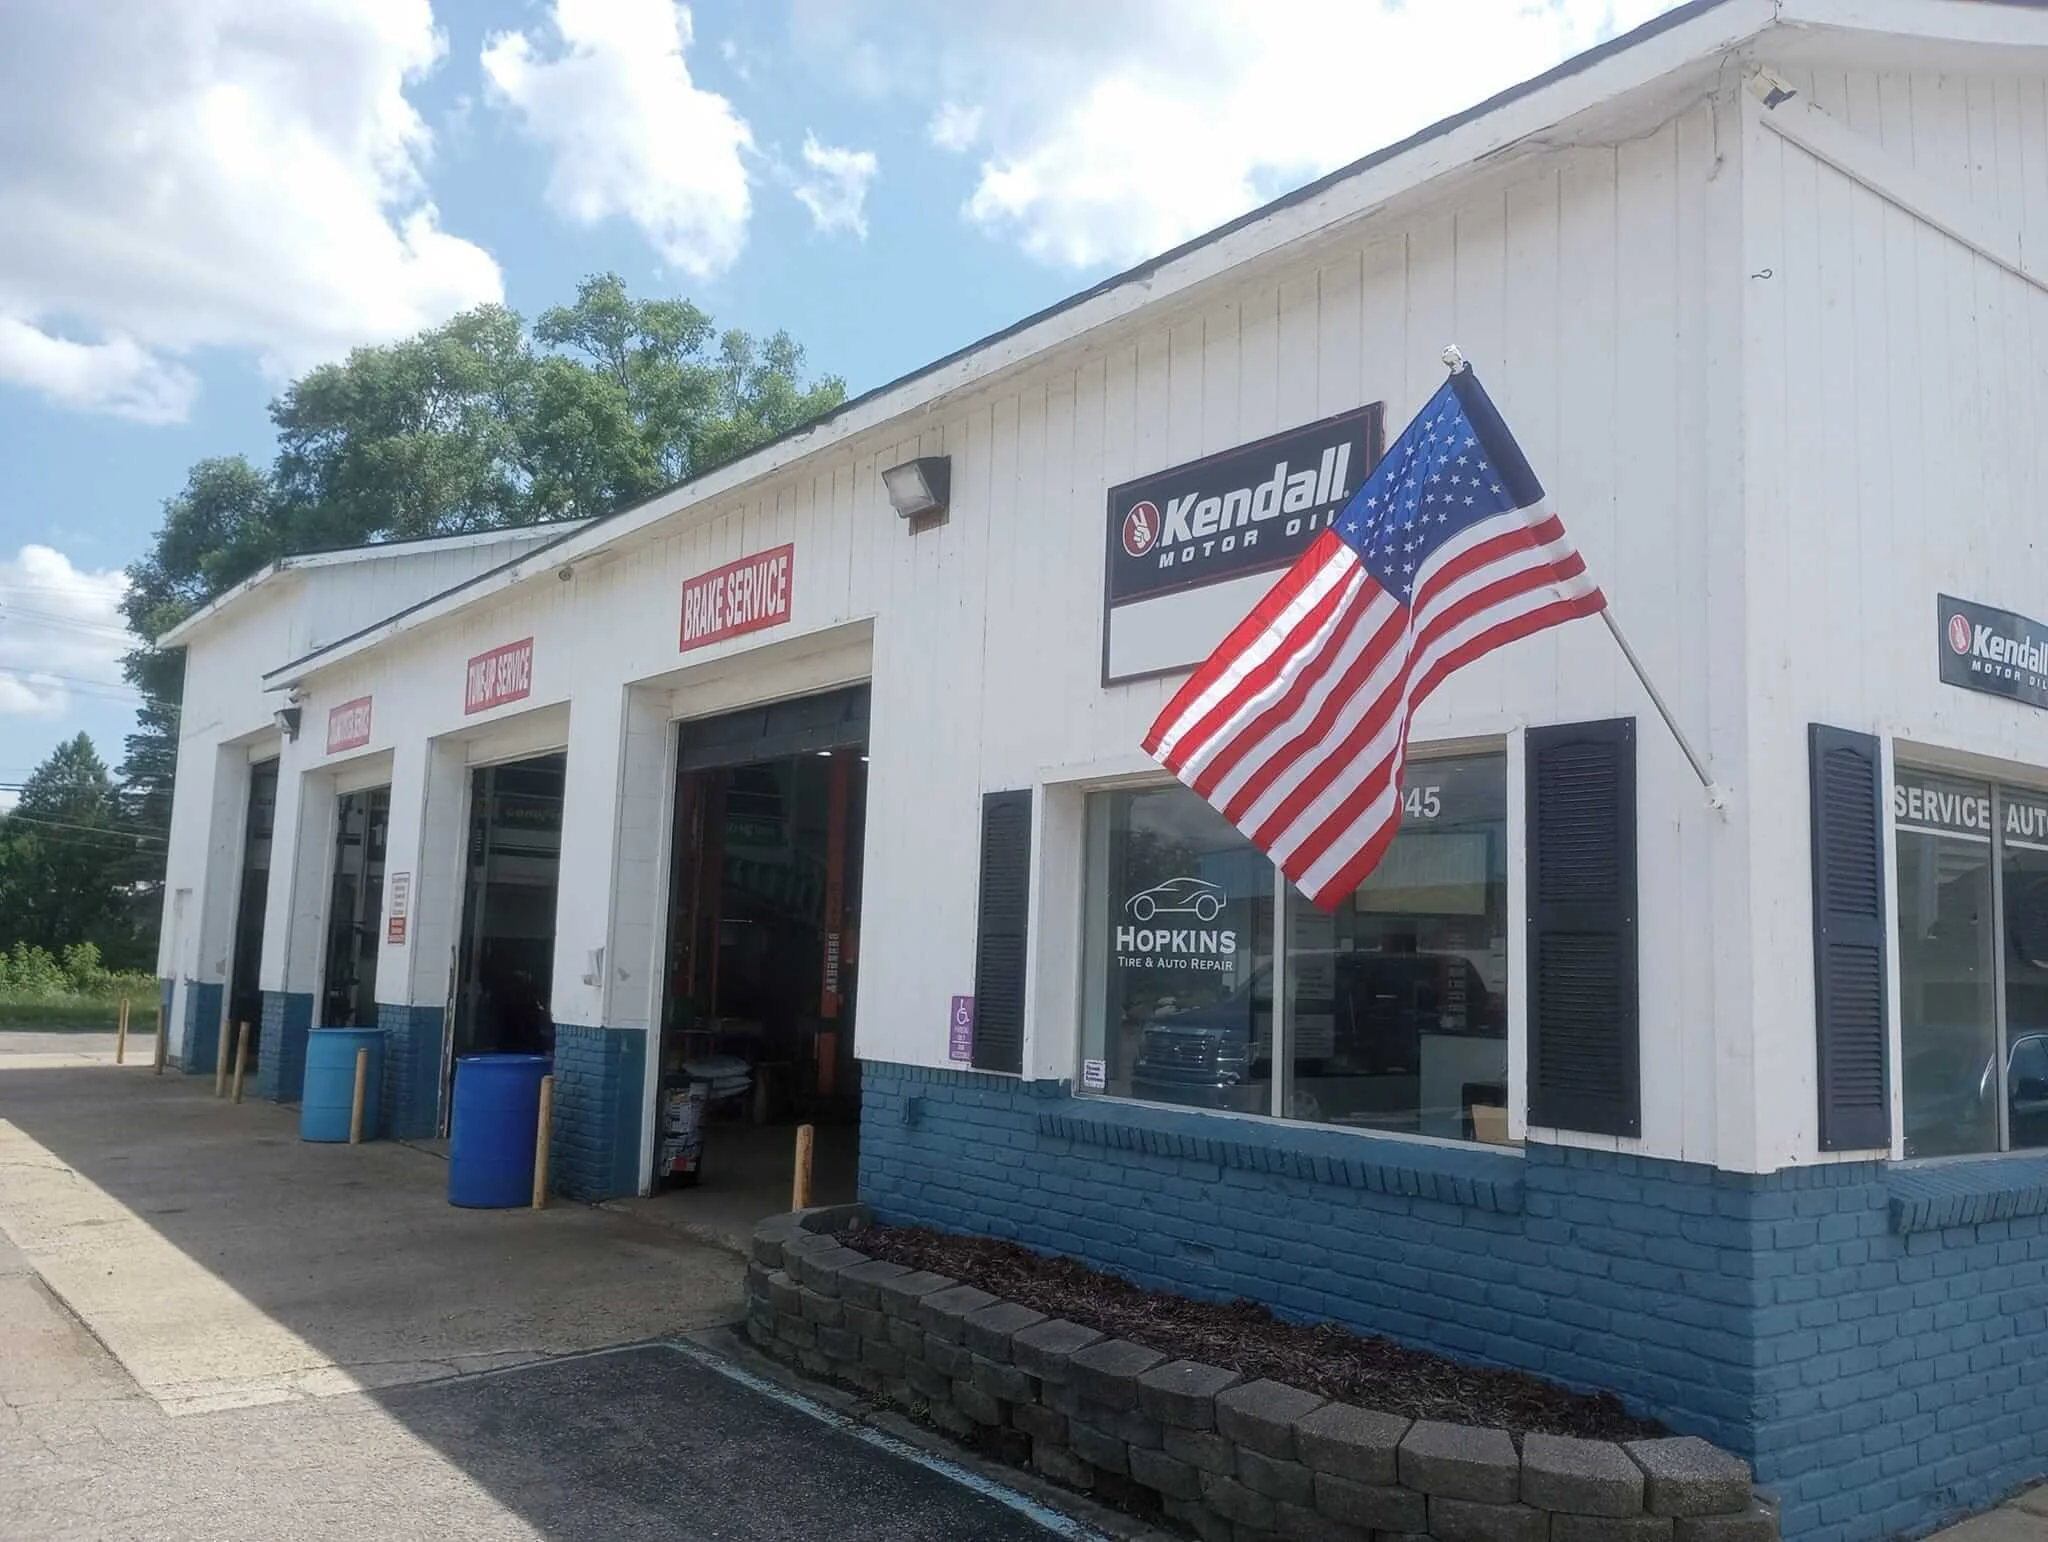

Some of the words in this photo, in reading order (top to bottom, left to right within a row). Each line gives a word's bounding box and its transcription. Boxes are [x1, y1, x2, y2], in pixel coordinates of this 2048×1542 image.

[1161, 442, 1352, 547] Kendall
[1158, 530, 1258, 569] MOTOR
[684, 577, 724, 640] BRAKE
[726, 556, 787, 628] SERVICE
[496, 646, 531, 696] SERVICE
[1971, 660, 2020, 680] MOTOR
[1973, 624, 2048, 676] Kendall
[1895, 785, 1990, 829] SERVICE
[2006, 803, 2048, 837] AUT
[1116, 926, 1236, 954] HOPKINS
[1117, 956, 1142, 968] TIRE
[1145, 957, 1153, 968] &
[1157, 957, 1187, 969] AUTO
[1191, 958, 1233, 971] REPAIR
